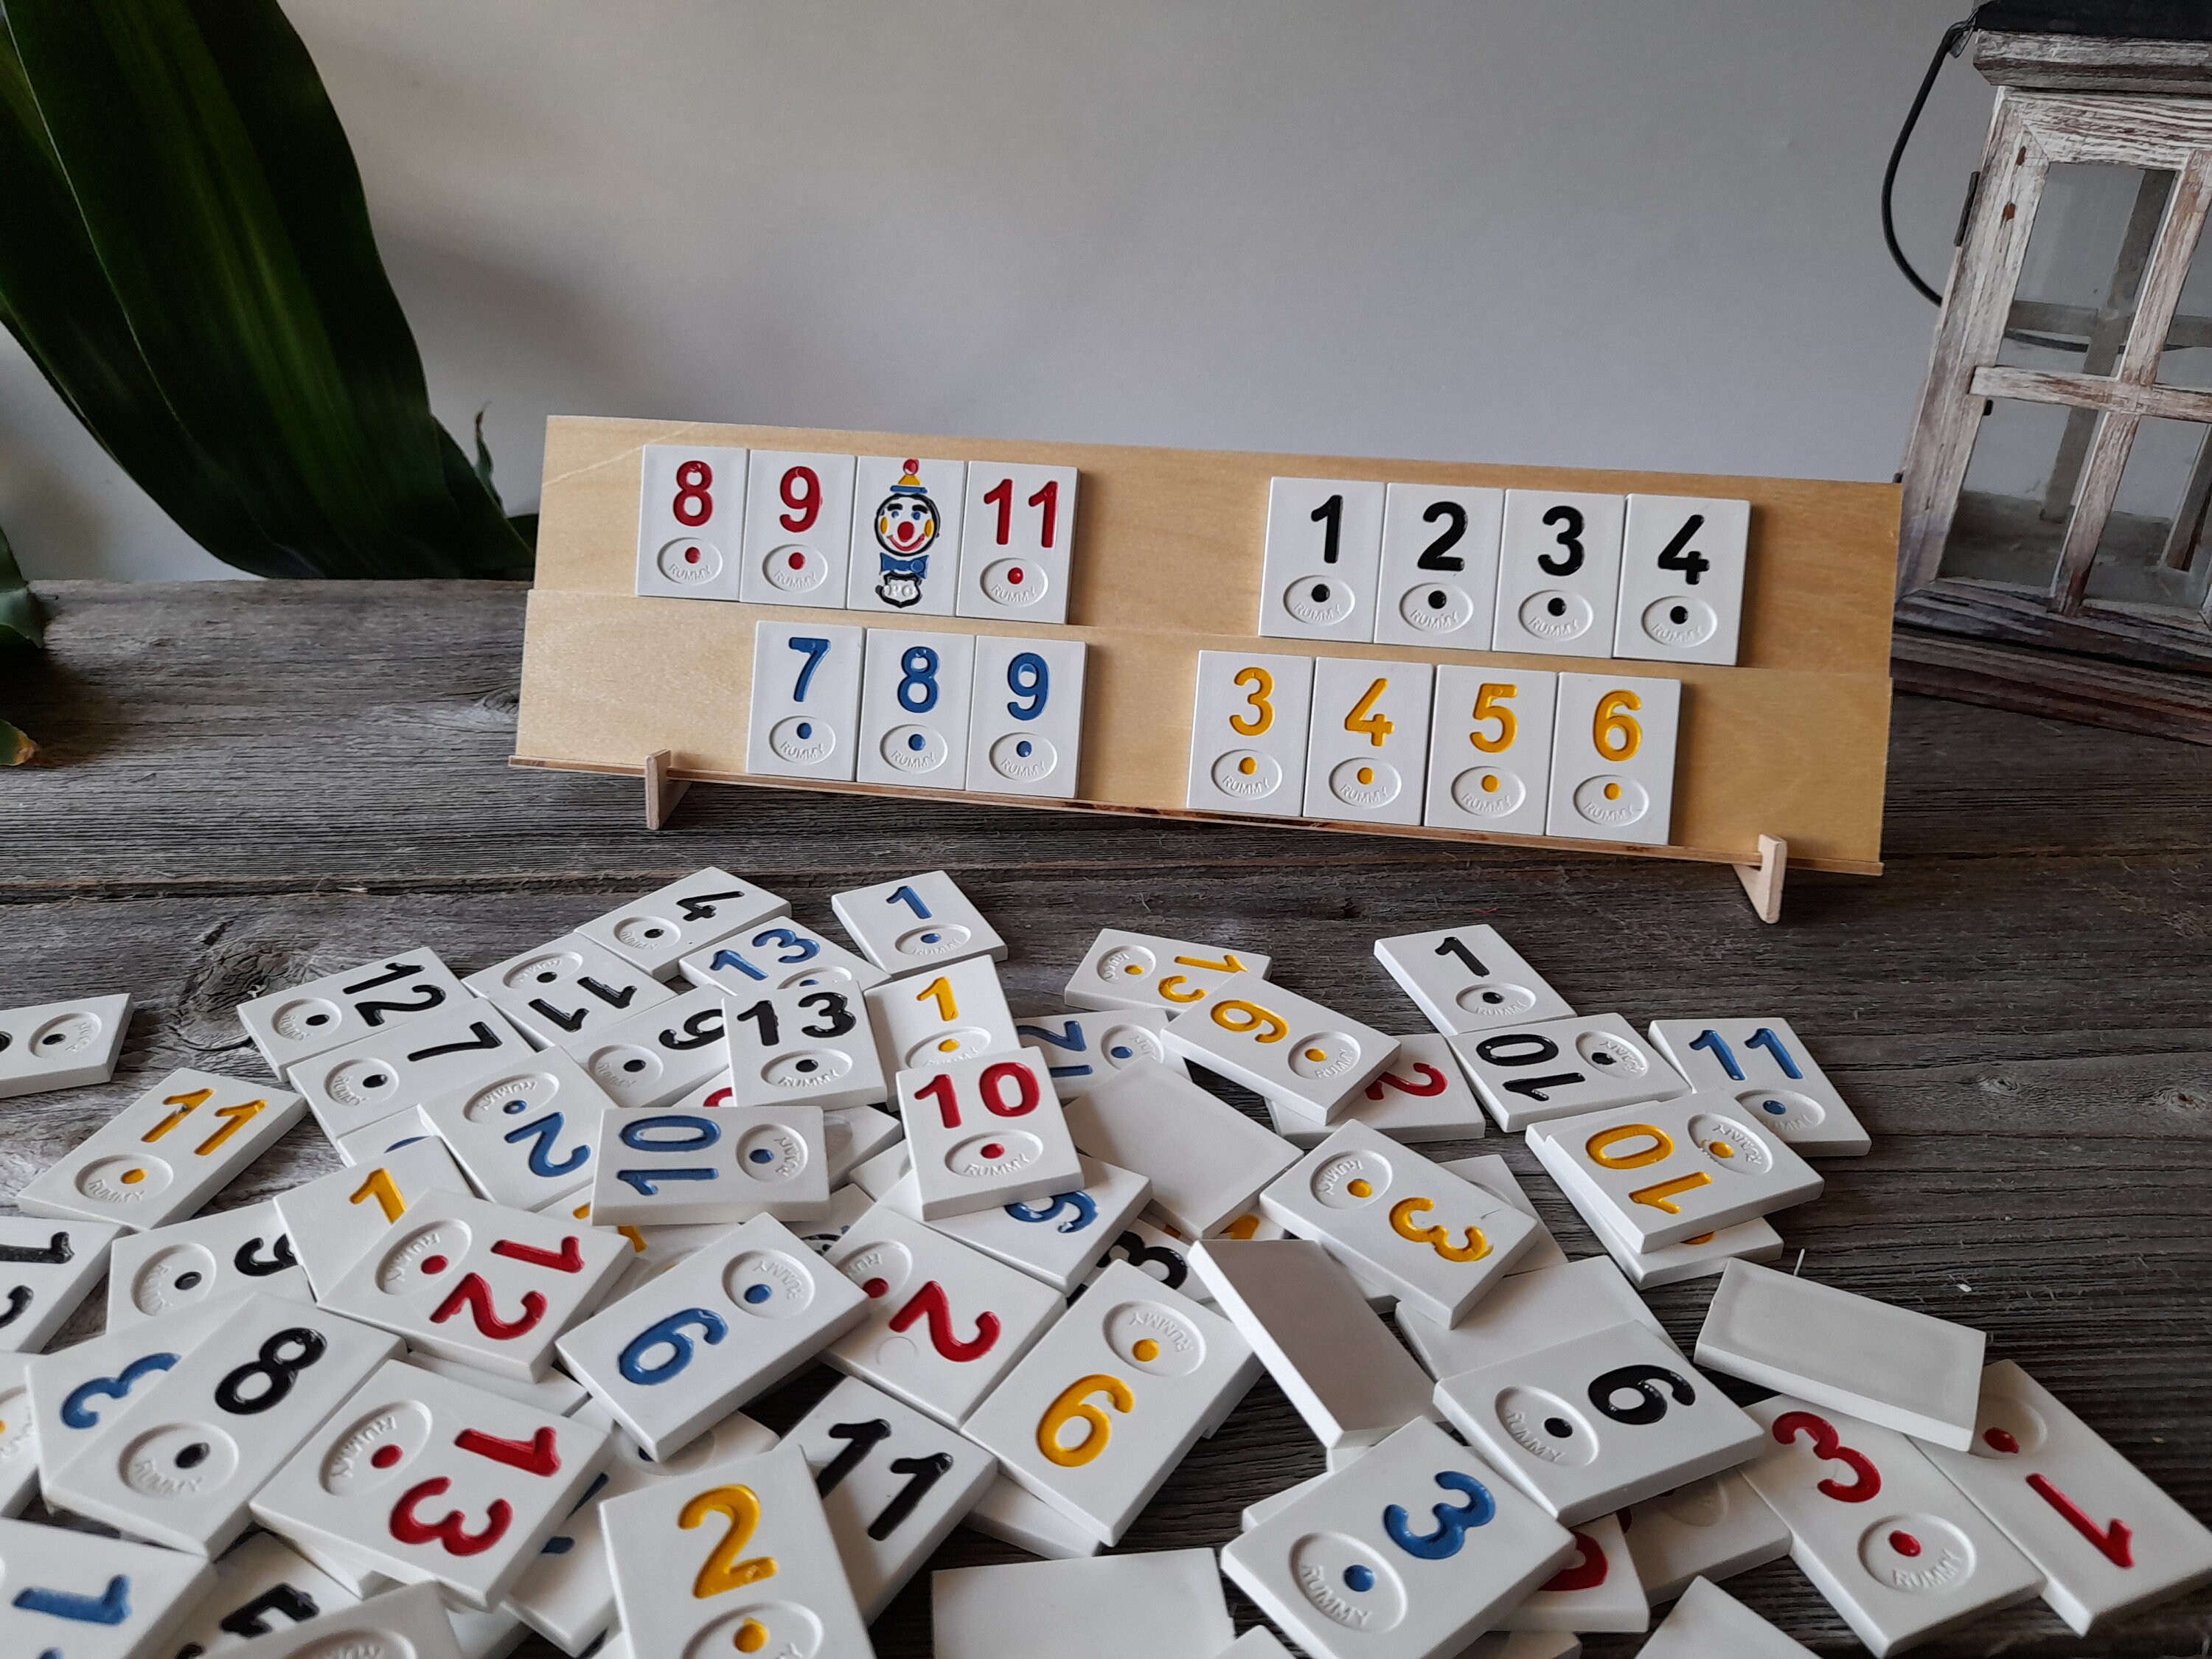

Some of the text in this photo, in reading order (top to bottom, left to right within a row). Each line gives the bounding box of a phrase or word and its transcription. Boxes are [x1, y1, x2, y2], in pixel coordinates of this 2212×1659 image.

[673, 460, 713, 526] 8
[779, 466, 821, 533] 9
[984, 479, 1057, 548] 11
[1310, 495, 1343, 564] 1
[1417, 501, 1467, 572] 2
[1537, 505, 1585, 577] 3
[1658, 514, 1710, 585] 4
[668, 563, 712, 581] RUMMY
[774, 570, 817, 588] RUMMY
[991, 583, 1037, 602] RUMMY
[1294, 601, 1340, 621] RUMMY
[1410, 608, 1459, 628] RUMMY
[1528, 617, 1578, 636] RUMMY
[1652, 623, 1701, 642] RUMMY
[788, 636, 830, 703] 7
[897, 646, 939, 714] 8
[1007, 652, 1049, 721] 9
[1230, 667, 1274, 737] 3
[1344, 678, 1394, 747] 4
[1470, 683, 1517, 754] 5
[1593, 689, 1642, 762] 6
[779, 740, 824, 760] RUMMY
[890, 749, 935, 768] RUMMY
[1000, 758, 1047, 778] RUMMY
[1222, 775, 1269, 794] RUMMY
[1340, 783, 1388, 803] RUMMY
[1461, 793, 1512, 813] RUMMY
[1584, 801, 1634, 821] RUMMY
[676, 891, 743, 922] 4
[886, 886, 931, 919] 1
[710, 928, 819, 981] 13
[914, 937, 962, 956] RUMMY
[1434, 936, 1490, 978] 1
[343, 962, 445, 1027] 12
[528, 976, 637, 1032] 11
[737, 992, 856, 1046] 13
[917, 977, 959, 1022] 1
[1476, 1000, 1527, 1016] RUMMY
[407, 1021, 502, 1062] 7
[1314, 1048, 1354, 1079] RUMMY
[1476, 1034, 1585, 1102] 10
[1689, 1028, 1803, 1081] 11
[778, 1068, 840, 1088] RUMMY
[914, 1062, 1040, 1128] 10
[142, 1089, 266, 1156] 11
[505, 1112, 591, 1178] 2
[618, 1116, 720, 1195] 10
[964, 1152, 1031, 1177] RUMMY
[1586, 1124, 1712, 1214] 10
[88, 1178, 145, 1203] RUMMY
[350, 1169, 406, 1223] 1
[1389, 1197, 1493, 1263] 3
[429, 1237, 585, 1340] 12
[888, 1281, 1000, 1363] 2
[1130, 1310, 1194, 1353] RUMMY
[215, 1327, 324, 1415] 8
[1506, 1411, 1566, 1462] RUMMY
[1772, 1411, 1881, 1503] 3
[389, 1427, 561, 1557] 13
[816, 1419, 953, 1541] 11
[678, 1484, 776, 1599] 2
[1383, 1471, 1495, 1560] 3
[2026, 1474, 2133, 1568] 1
[1299, 1565, 1372, 1625] RUMMY
[1892, 1548, 1963, 1587] RUMMY
